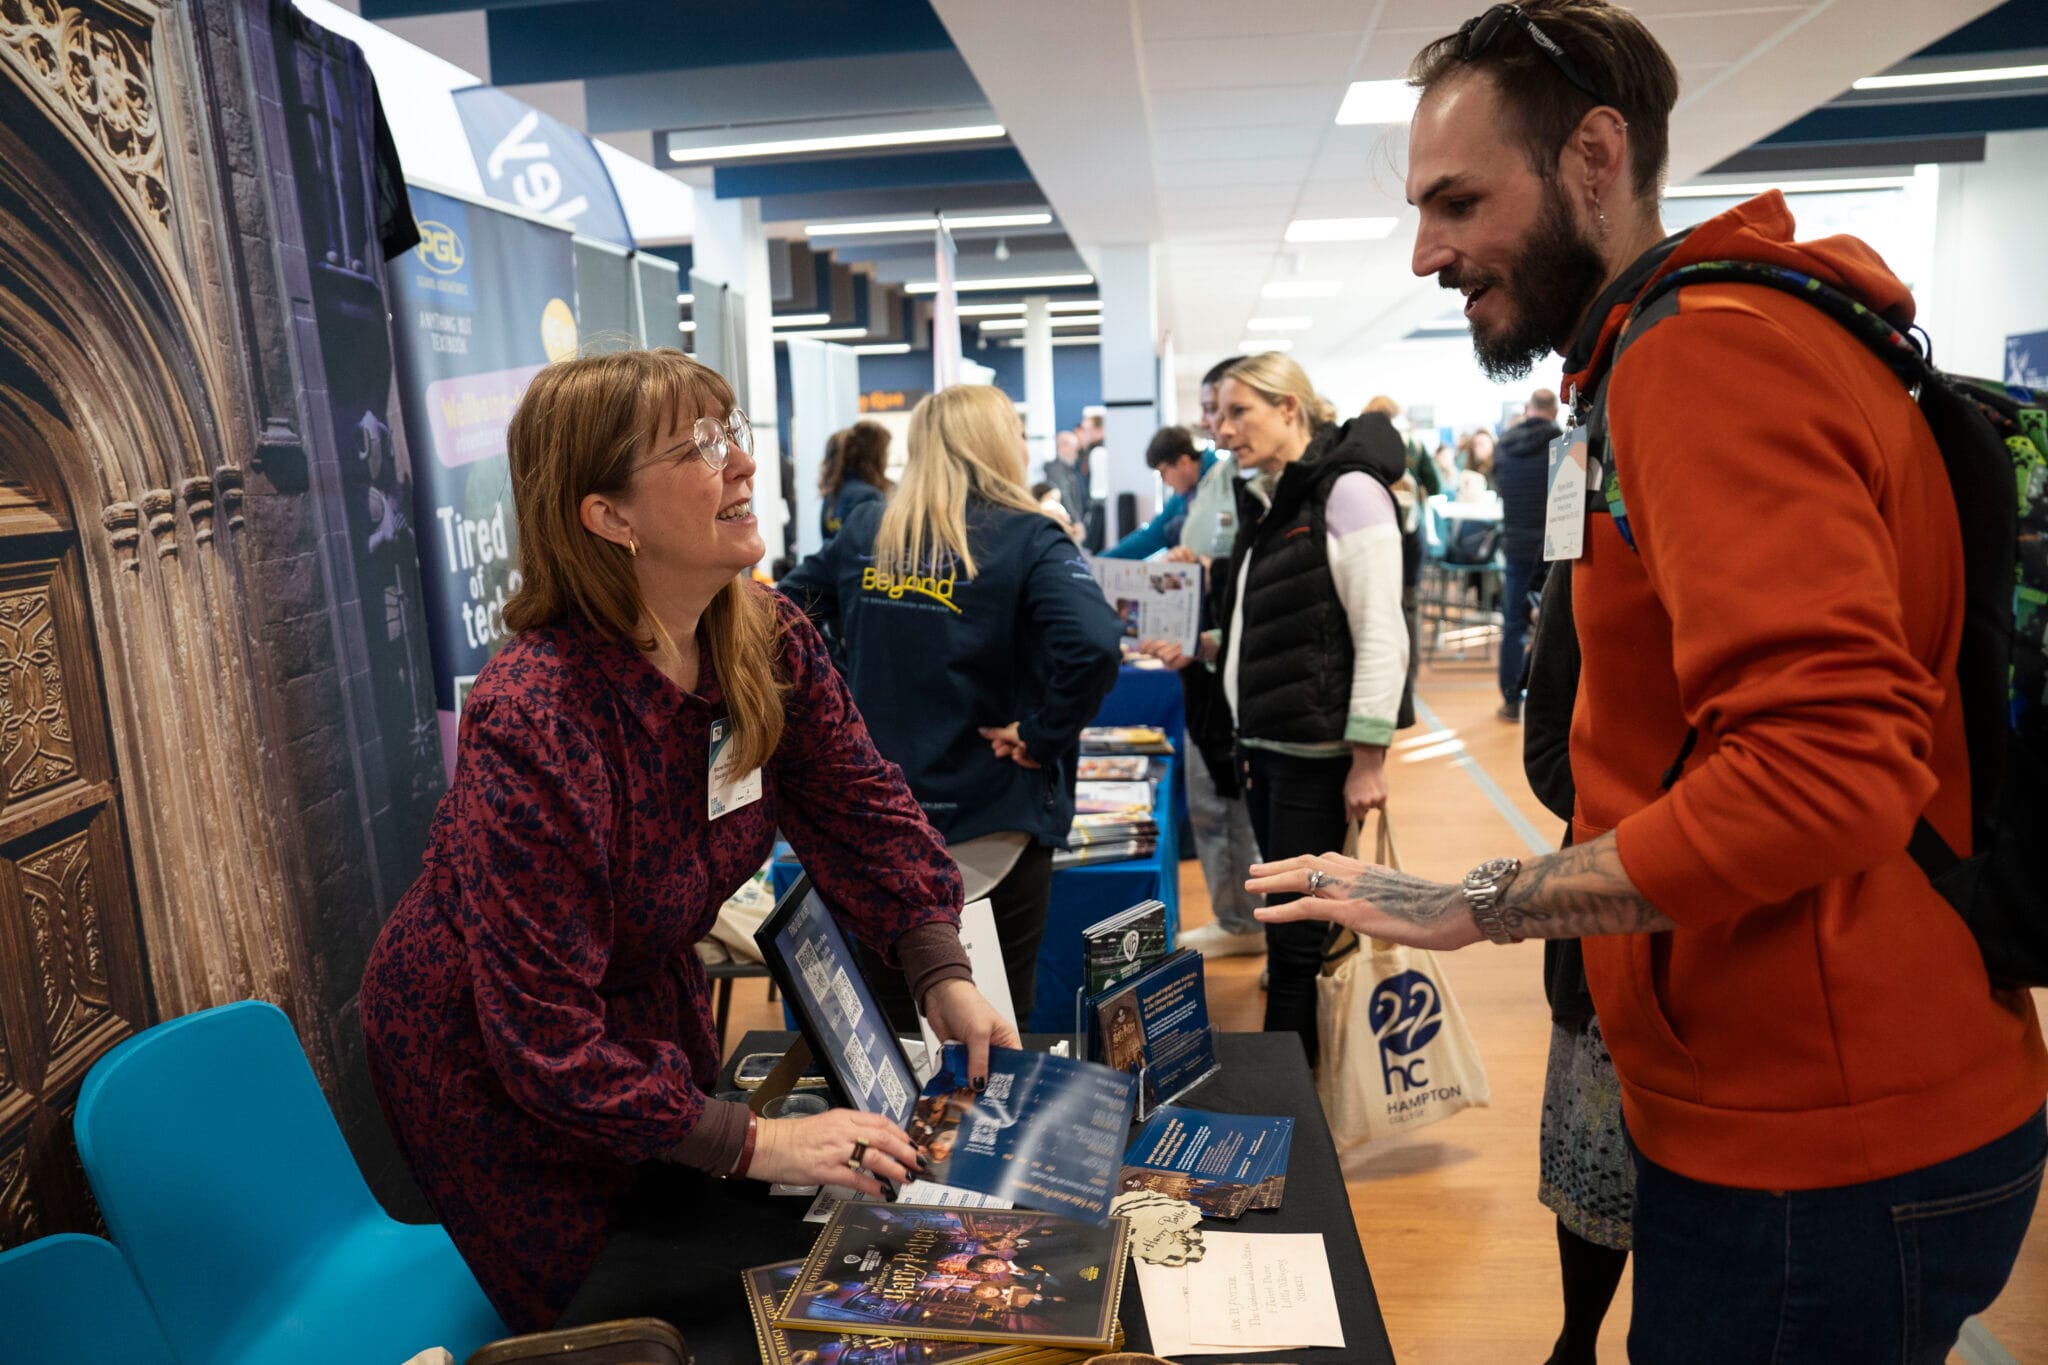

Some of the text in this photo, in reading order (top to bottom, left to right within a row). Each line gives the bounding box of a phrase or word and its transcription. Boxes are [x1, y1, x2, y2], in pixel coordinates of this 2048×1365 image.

[419, 228, 463, 265] PGL
[436, 501, 508, 573] Tired
[469, 564, 485, 600] of
[862, 567, 958, 607] Beyond
[1379, 1041, 1429, 1095] hc
[1387, 1084, 1462, 1115] HAMPTON
[1158, 1207, 1189, 1227] Potter
[812, 1247, 833, 1282] OFFICIAL
[829, 1225, 845, 1248] GUIDE
[1143, 1229, 1175, 1252] Harry
[882, 1227, 940, 1302] Harry Potter
[762, 1294, 776, 1319] GUIDE
